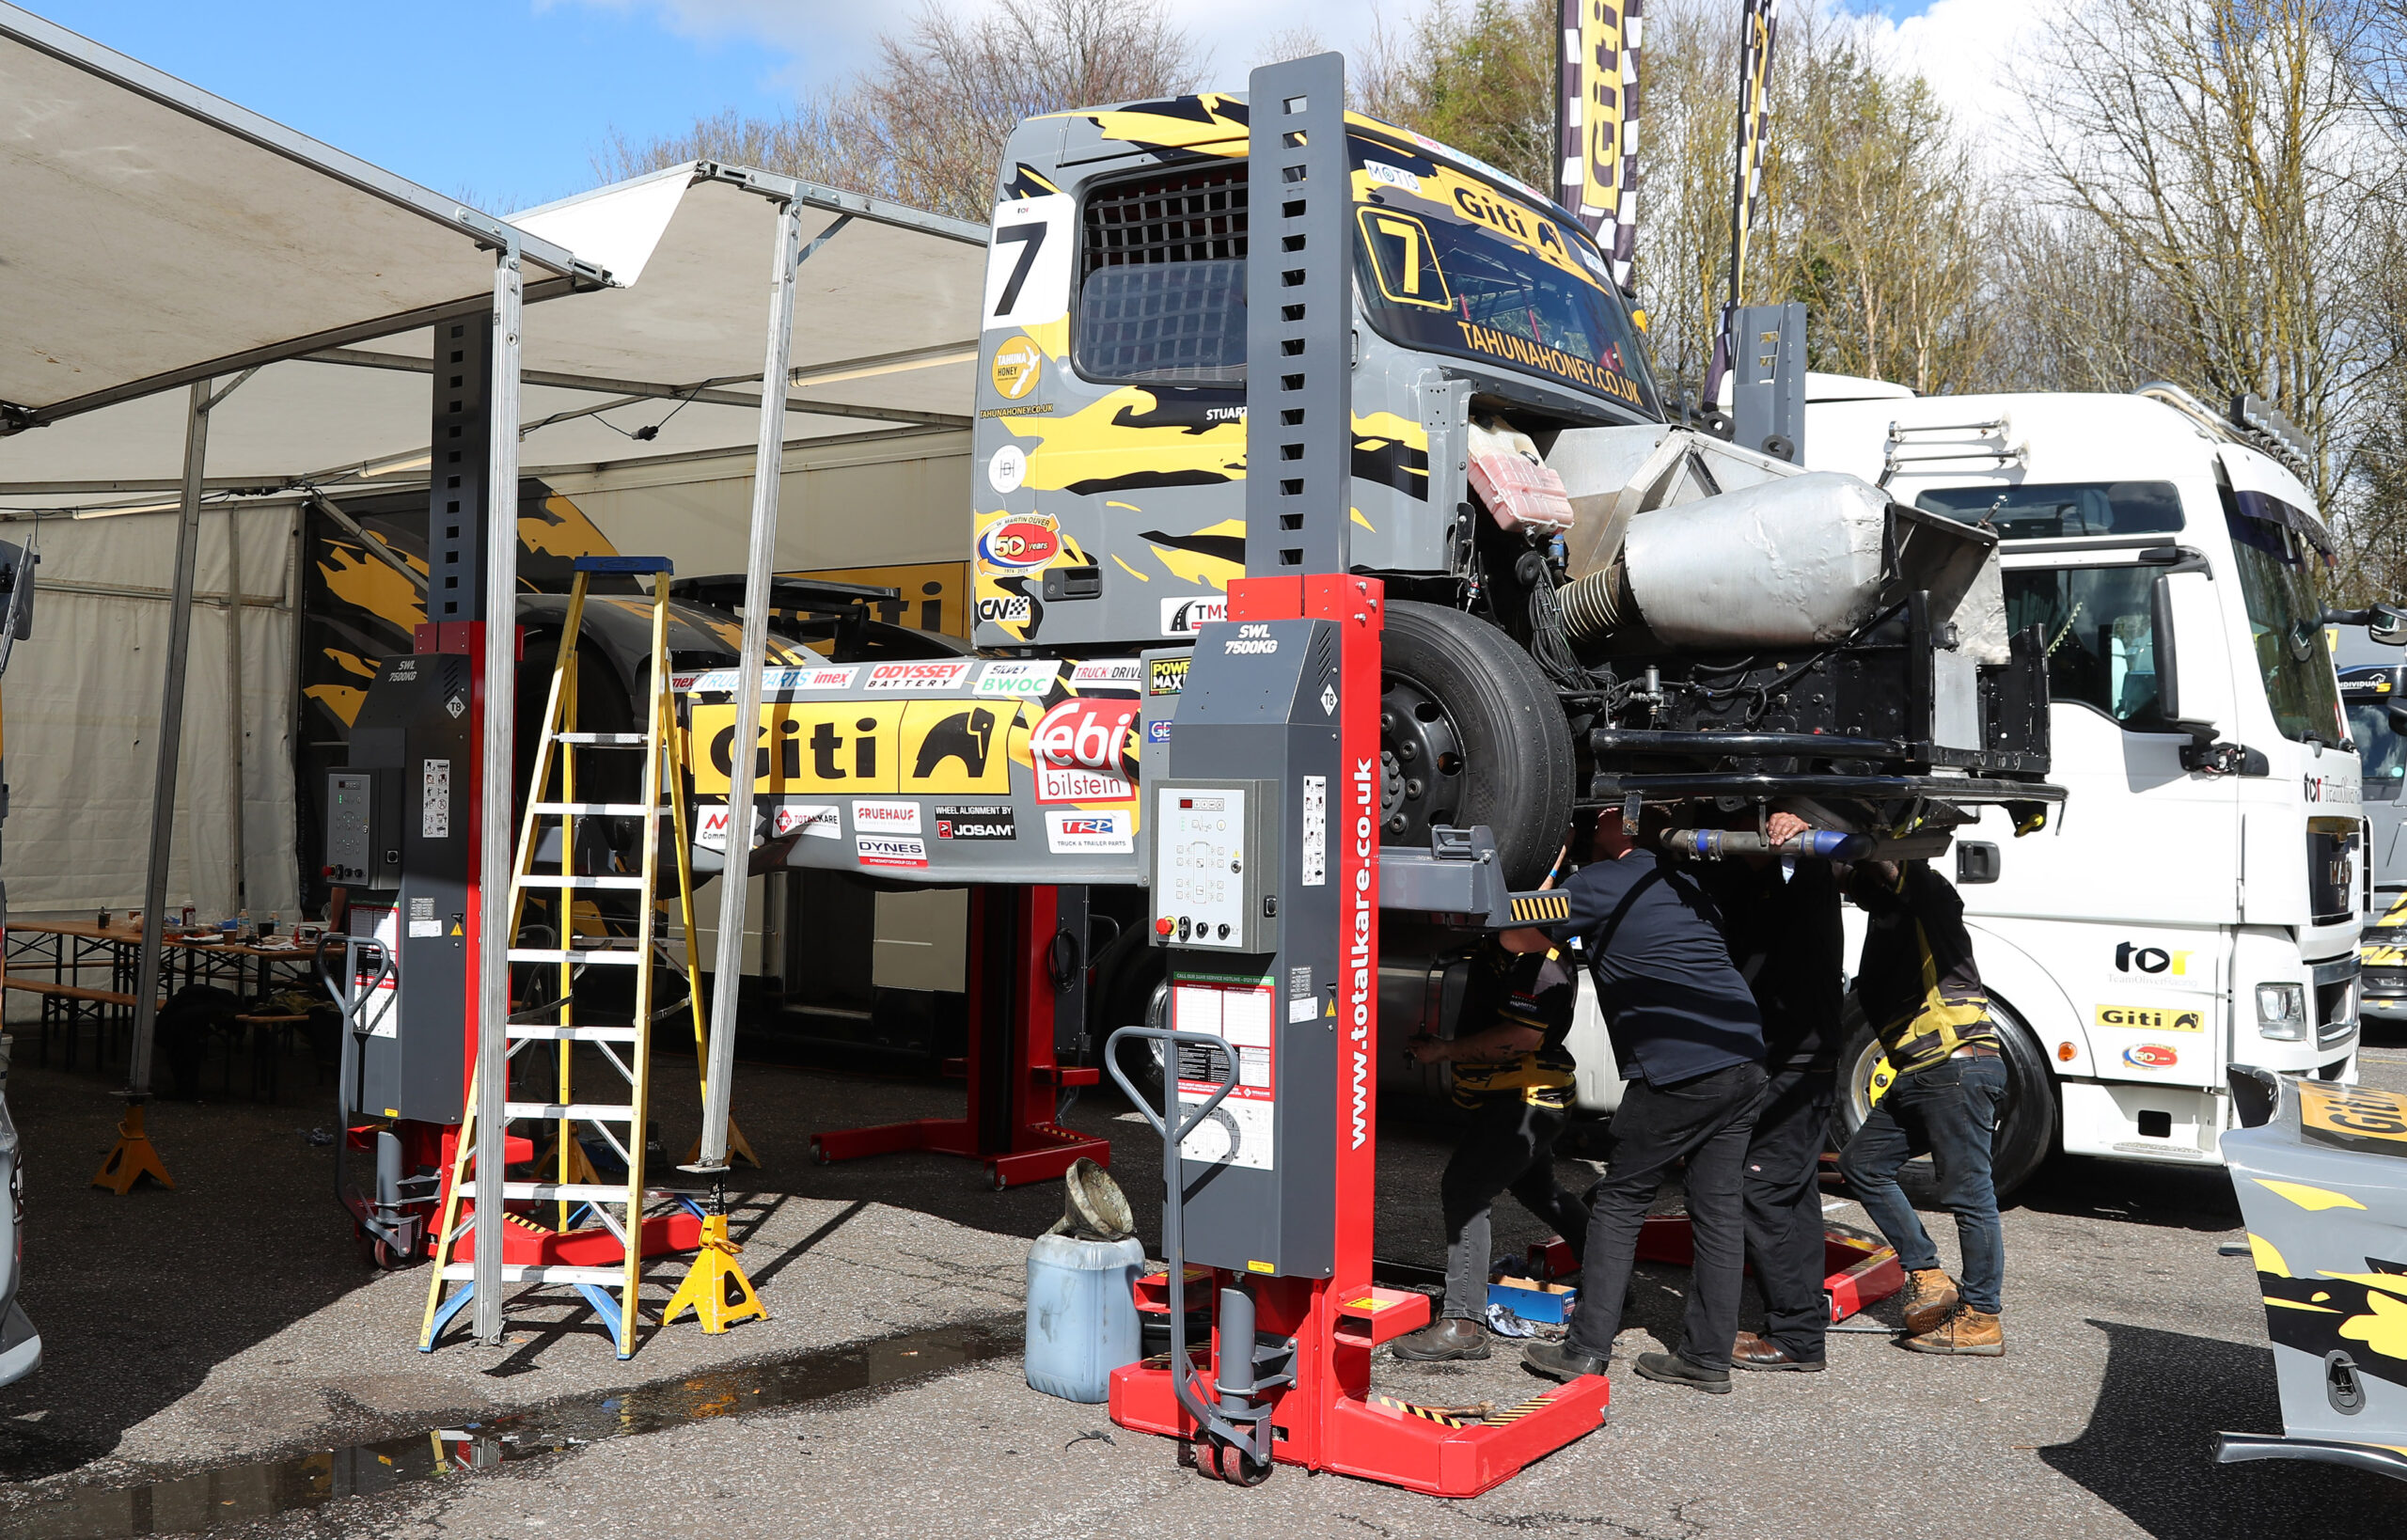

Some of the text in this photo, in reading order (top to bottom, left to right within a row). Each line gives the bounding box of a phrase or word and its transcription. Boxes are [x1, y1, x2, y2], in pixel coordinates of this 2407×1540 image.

[1367, 163, 1419, 190] MOTIS
[1453, 187, 1530, 239] Giti
[1377, 217, 1419, 295] 7
[994, 221, 1048, 317] 7
[997, 352, 1027, 367] TAHUNA
[1457, 321, 1644, 407] TAHUNAHONEY.CO.UK
[998, 366, 1018, 377] HONEY
[980, 403, 1053, 419] TAHUNAHONEY.CO.UK
[1028, 517, 1050, 526] OLIVER
[995, 535, 1048, 558] 50 years
[1237, 623, 1271, 639] SWL
[1224, 639, 1279, 655] 7500KG
[399, 660, 416, 670] SWL
[873, 665, 966, 679] ODYSSEY
[990, 665, 1030, 675] SILVEY
[1153, 661, 1192, 676] POWE
[388, 671, 417, 683] 7500KG
[671, 676, 696, 688] mex
[700, 674, 740, 688] TRUC
[813, 670, 848, 684] imex
[1076, 668, 1108, 679] TRUCK
[868, 679, 952, 688] BATTERY
[982, 678, 1046, 692] BWOC
[1153, 674, 1187, 690] MAX
[2338, 680, 2379, 688] NDIVIDUAL
[449, 701, 462, 712] T8
[1324, 693, 1335, 707] T8
[1030, 702, 1131, 767] febi
[710, 717, 877, 779] Giti
[1046, 773, 1122, 796] bilstein
[858, 807, 914, 821] FRUEHAUF
[935, 806, 1012, 815] WHEEL ALIGNMENT BY
[794, 814, 839, 825] TOTALKARE
[1062, 819, 1112, 834] TRP
[702, 831, 728, 841] Comm
[953, 824, 1012, 836] JOSAM
[858, 841, 922, 854] DYNES
[1351, 757, 1373, 1151] www.totalkare.co.uk
[2101, 1010, 2162, 1027] Giti
